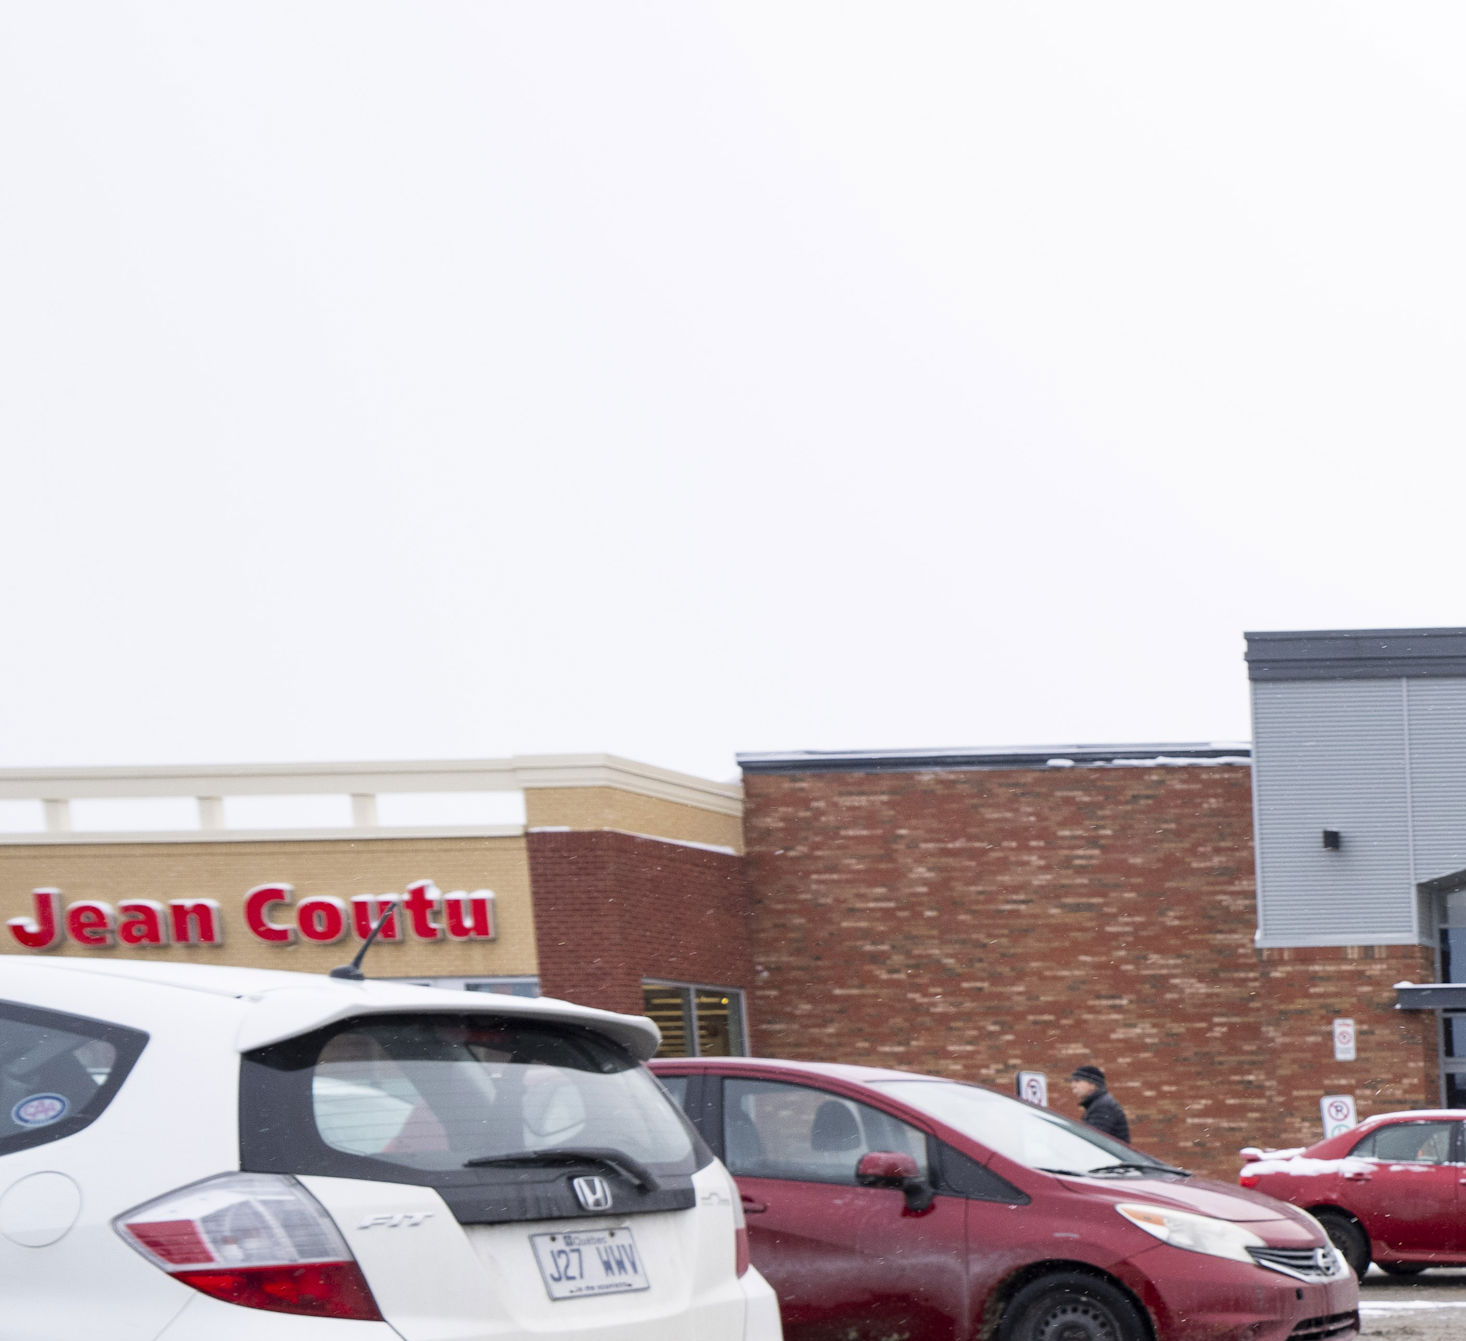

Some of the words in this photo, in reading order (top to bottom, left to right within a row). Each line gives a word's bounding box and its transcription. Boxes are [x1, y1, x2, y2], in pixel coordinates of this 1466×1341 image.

[6, 887, 221, 950] Jean
[243, 879, 497, 945] Coutu
[357, 1213, 434, 1230] FIT
[550, 1248, 583, 1282] J27
[595, 1243, 638, 1277] WWV
